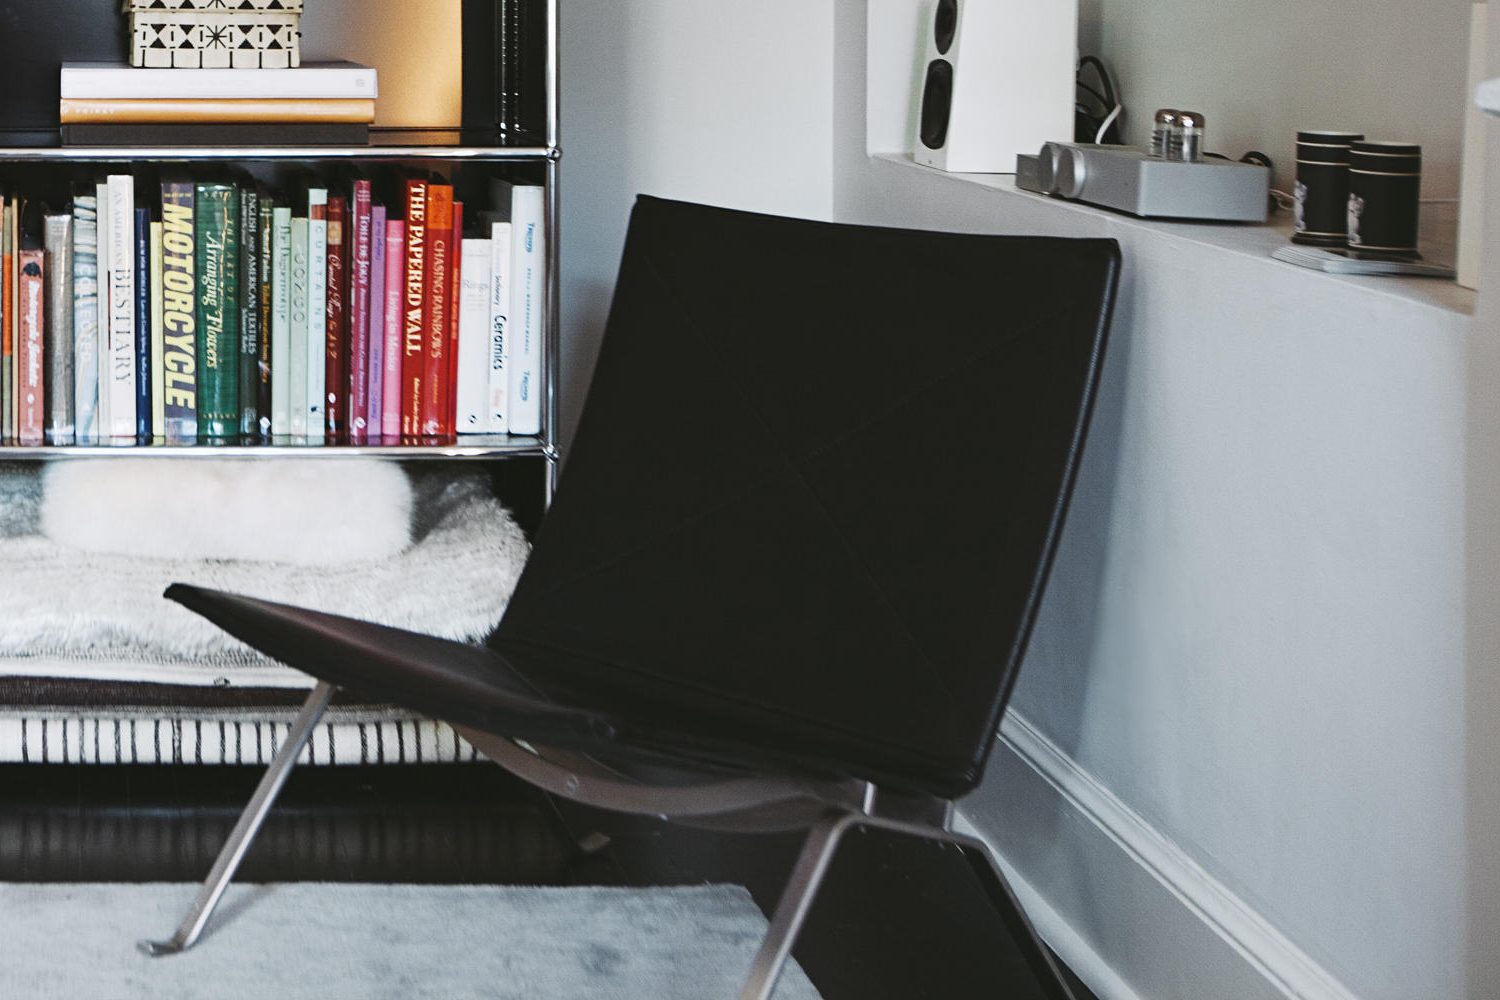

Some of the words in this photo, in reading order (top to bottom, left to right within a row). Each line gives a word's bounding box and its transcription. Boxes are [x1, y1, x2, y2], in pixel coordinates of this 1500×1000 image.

[114, 191, 122, 205] AN
[248, 193, 256, 232] ENGLISH
[409, 184, 425, 221] THE
[114, 208, 123, 265] AMERICAN
[359, 214, 369, 242] TOILE
[203, 231, 222, 306] Arranging
[248, 255, 256, 309] AMERICAN
[262, 256, 270, 283] Fashion
[314, 225, 323, 330] CURTAINS
[356, 260, 368, 286] JOUY
[408, 225, 424, 306] PAPERED
[433, 240, 445, 293] CHASING
[163, 203, 195, 409] MOTORCYCLE
[227, 286, 234, 304] OF
[262, 284, 270, 305] Tribal
[386, 291, 398, 322] Living
[115, 269, 131, 385] BESTIARY
[206, 310, 222, 369] Flowers
[248, 312, 256, 354] TEXTILES
[388, 324, 397, 335] in
[406, 309, 422, 356] WALL
[431, 295, 443, 358] RAINBOWS
[493, 315, 508, 370] Ceramics
[387, 337, 398, 371] Mexico
